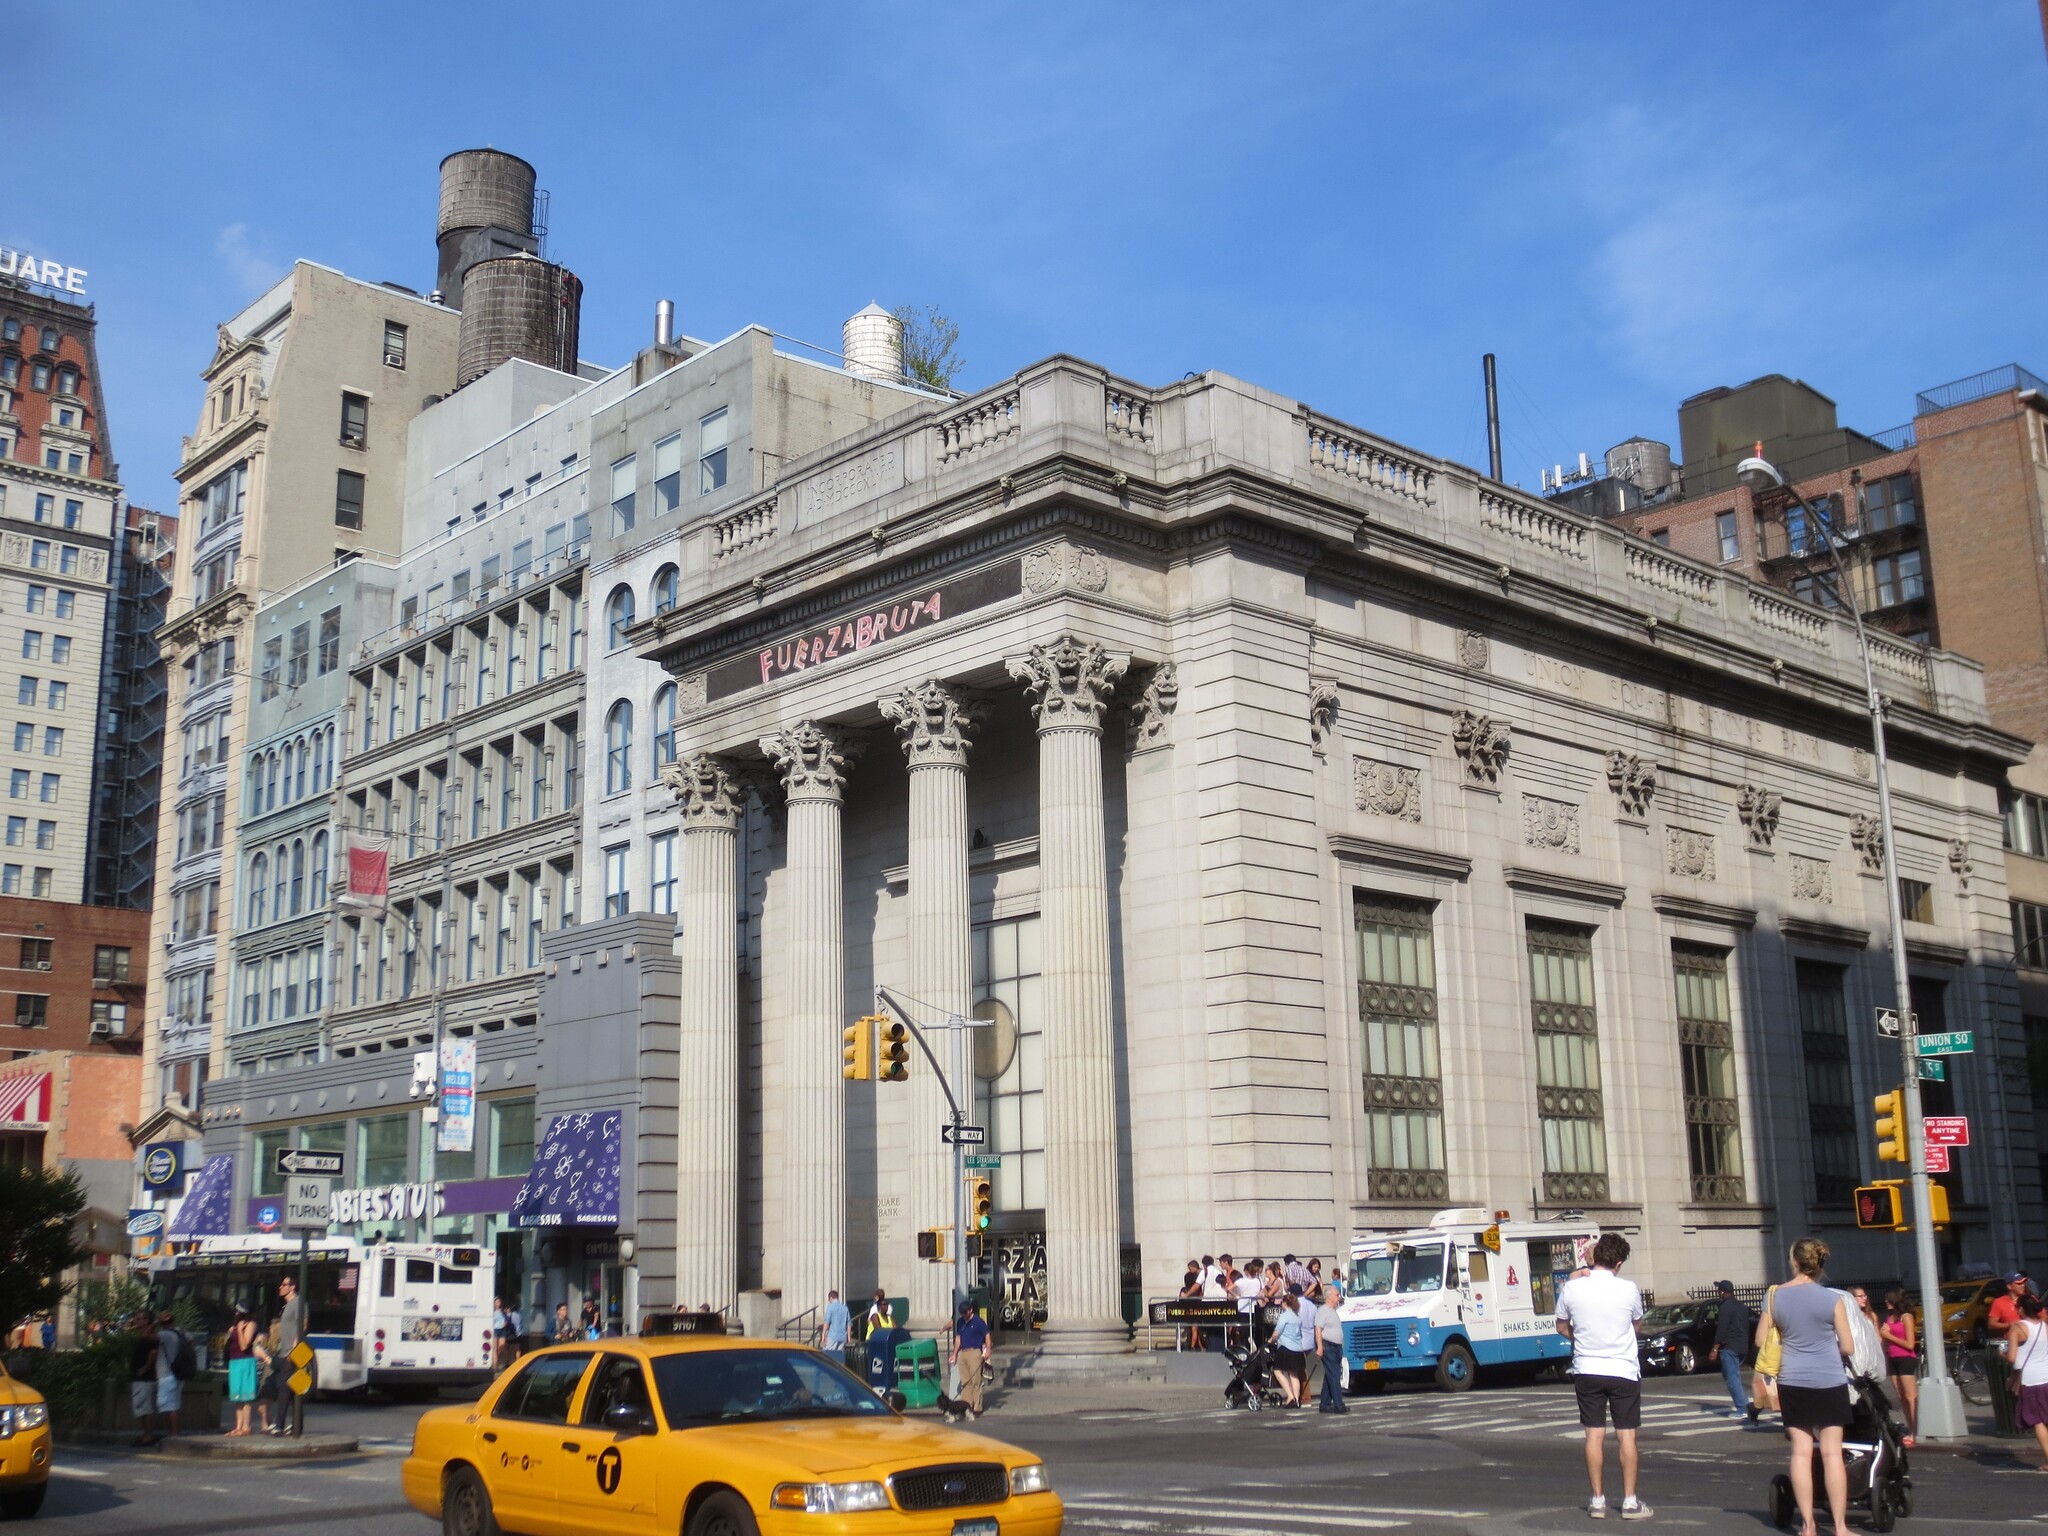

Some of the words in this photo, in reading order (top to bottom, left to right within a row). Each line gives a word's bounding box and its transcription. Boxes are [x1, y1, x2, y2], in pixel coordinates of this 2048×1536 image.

[807, 451, 894, 494] INCORPORATED
[759, 592, 941, 683] FUERZABRUTA
[1523, 653, 1585, 690] UNION
[1610, 679, 1677, 718] SQUARE
[1885, 1017, 1896, 1029] ONE
[1921, 1034, 1951, 1047] UNION
[1955, 1033, 1968, 1045] SQ
[967, 1131, 980, 1139] WAY
[287, 1156, 306, 1168] ONE
[314, 1157, 336, 1169] WAY
[967, 1155, 975, 1164] LEE
[300, 1184, 318, 1199] NO
[289, 1204, 328, 1219] TURNS
[879, 1208, 898, 1217] BANK
[1534, 1320, 1556, 1330] SUNDA
[603, 1455, 618, 1490] T
